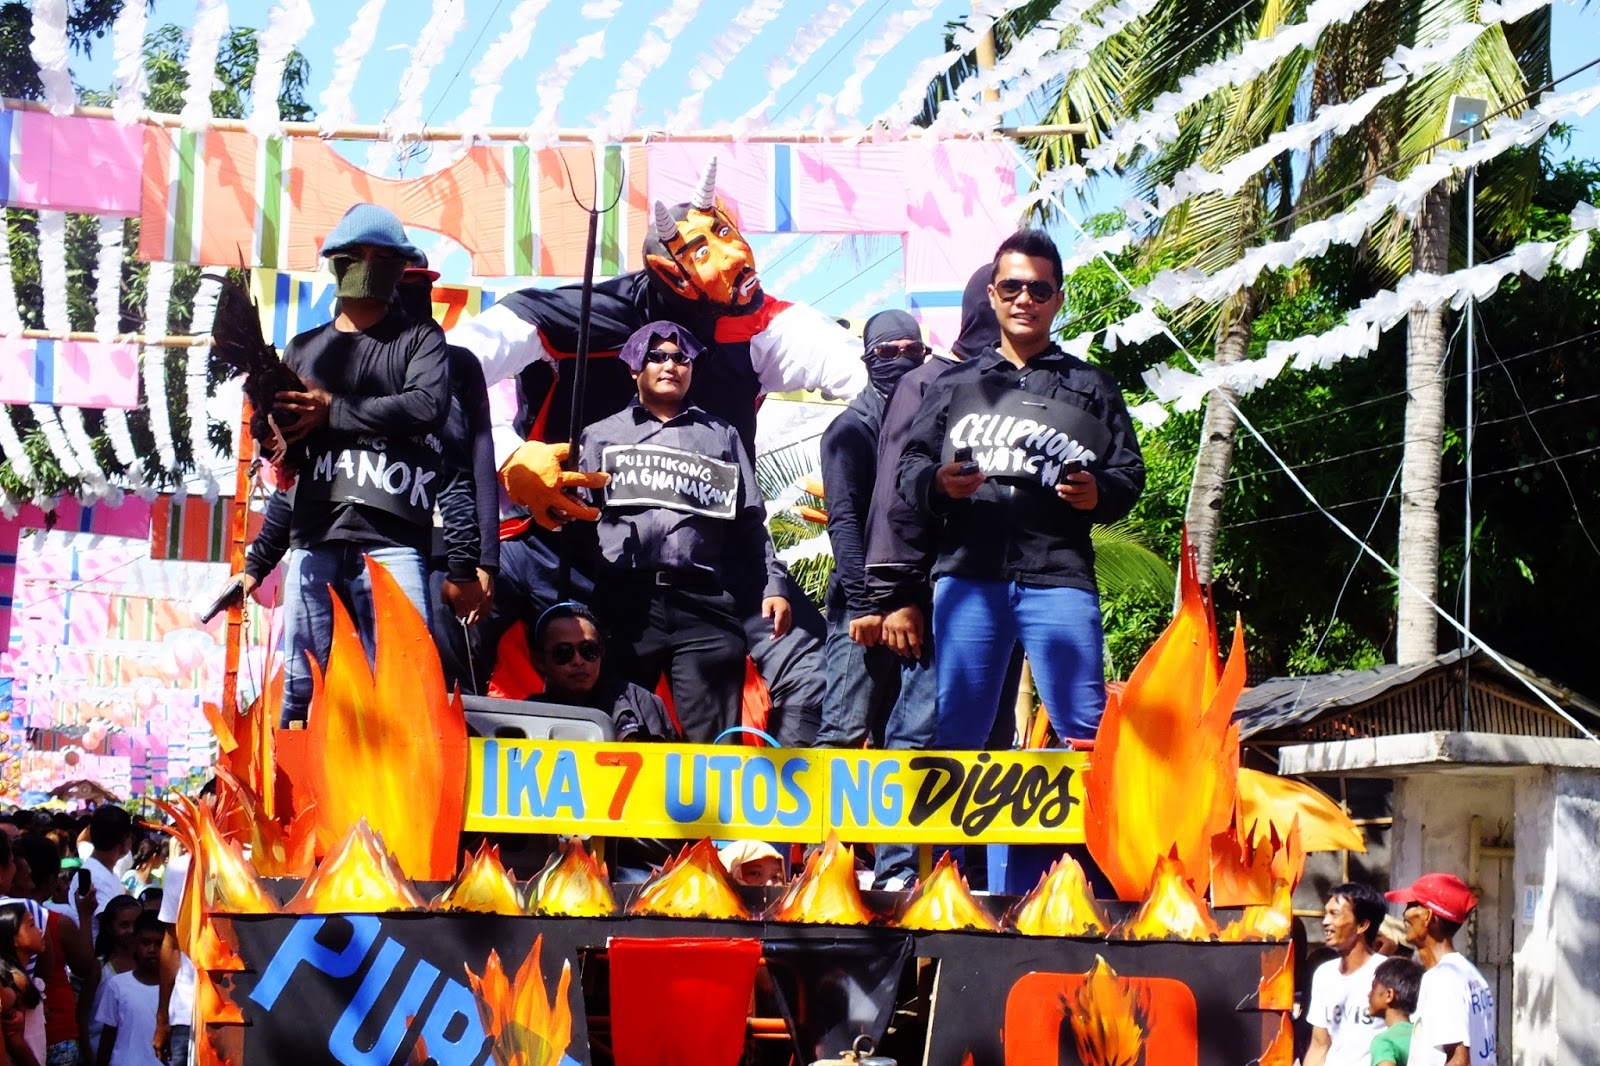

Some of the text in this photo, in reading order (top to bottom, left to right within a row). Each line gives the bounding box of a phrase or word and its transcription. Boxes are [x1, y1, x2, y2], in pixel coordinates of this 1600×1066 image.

[272, 272, 337, 349] IK
[313, 449, 436, 510] MANOK
[611, 468, 735, 506] MAGNANAKAW
[615, 454, 712, 482] PULITIKONG
[481, 740, 1080, 836] IKA 7 UTOS NG Diyos
